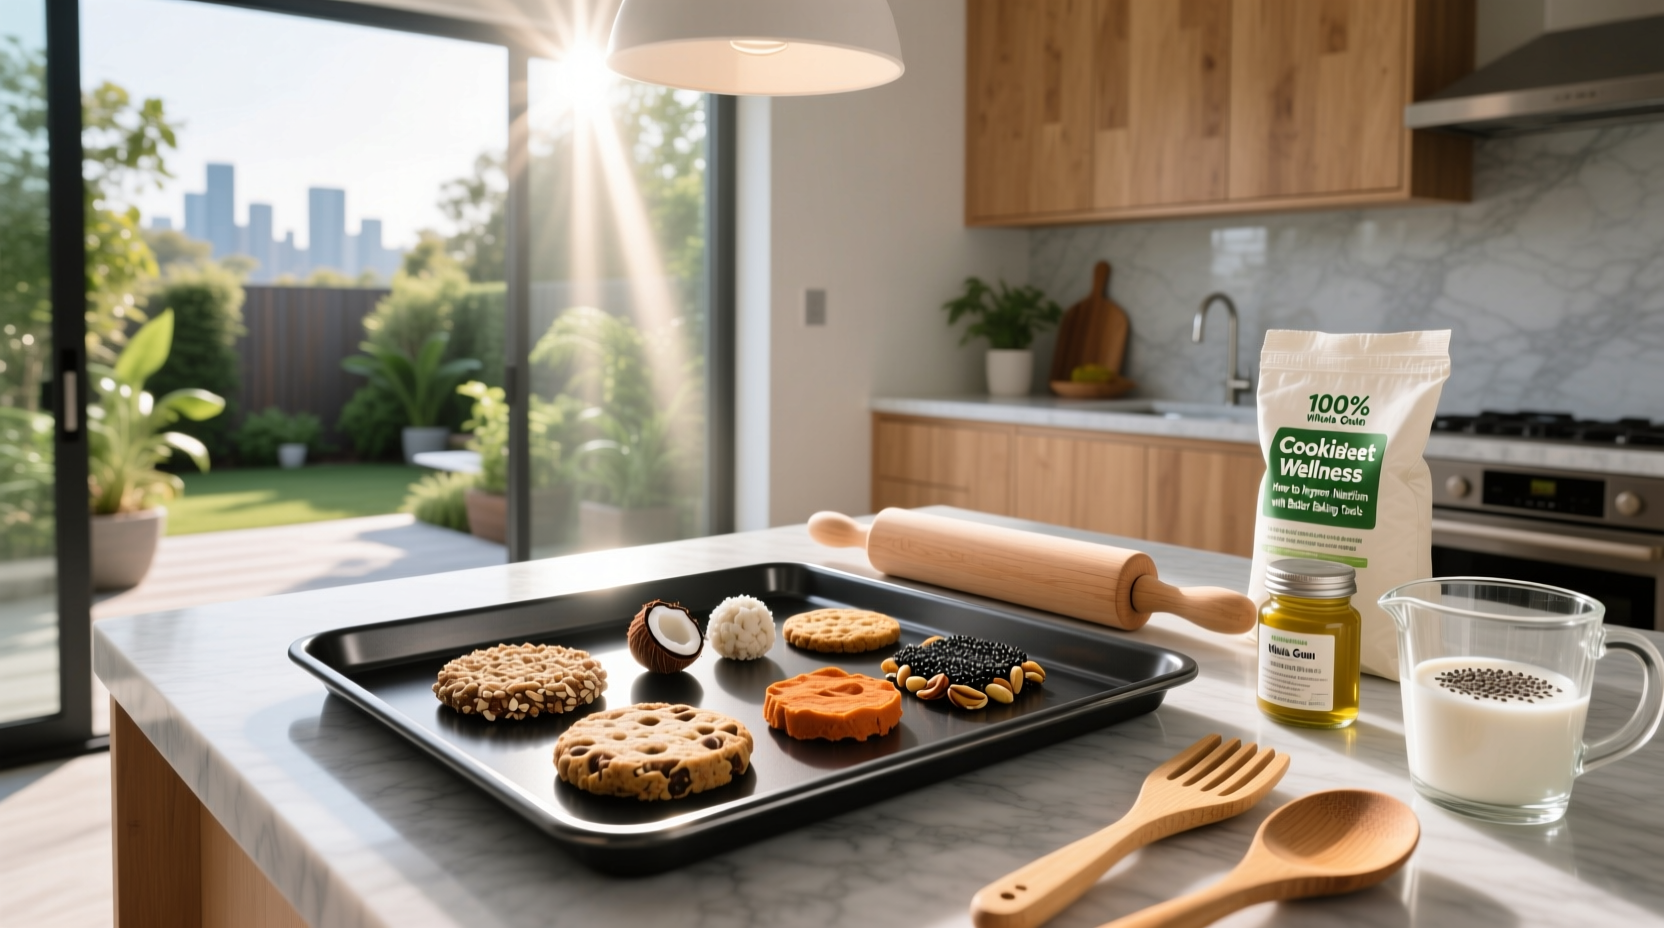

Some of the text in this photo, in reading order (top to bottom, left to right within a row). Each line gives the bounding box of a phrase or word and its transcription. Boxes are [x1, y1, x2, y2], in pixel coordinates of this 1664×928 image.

[1309, 394, 1370, 416] 100%
[1280, 458, 1363, 483] Wellness
[1291, 484, 1300, 494] to
